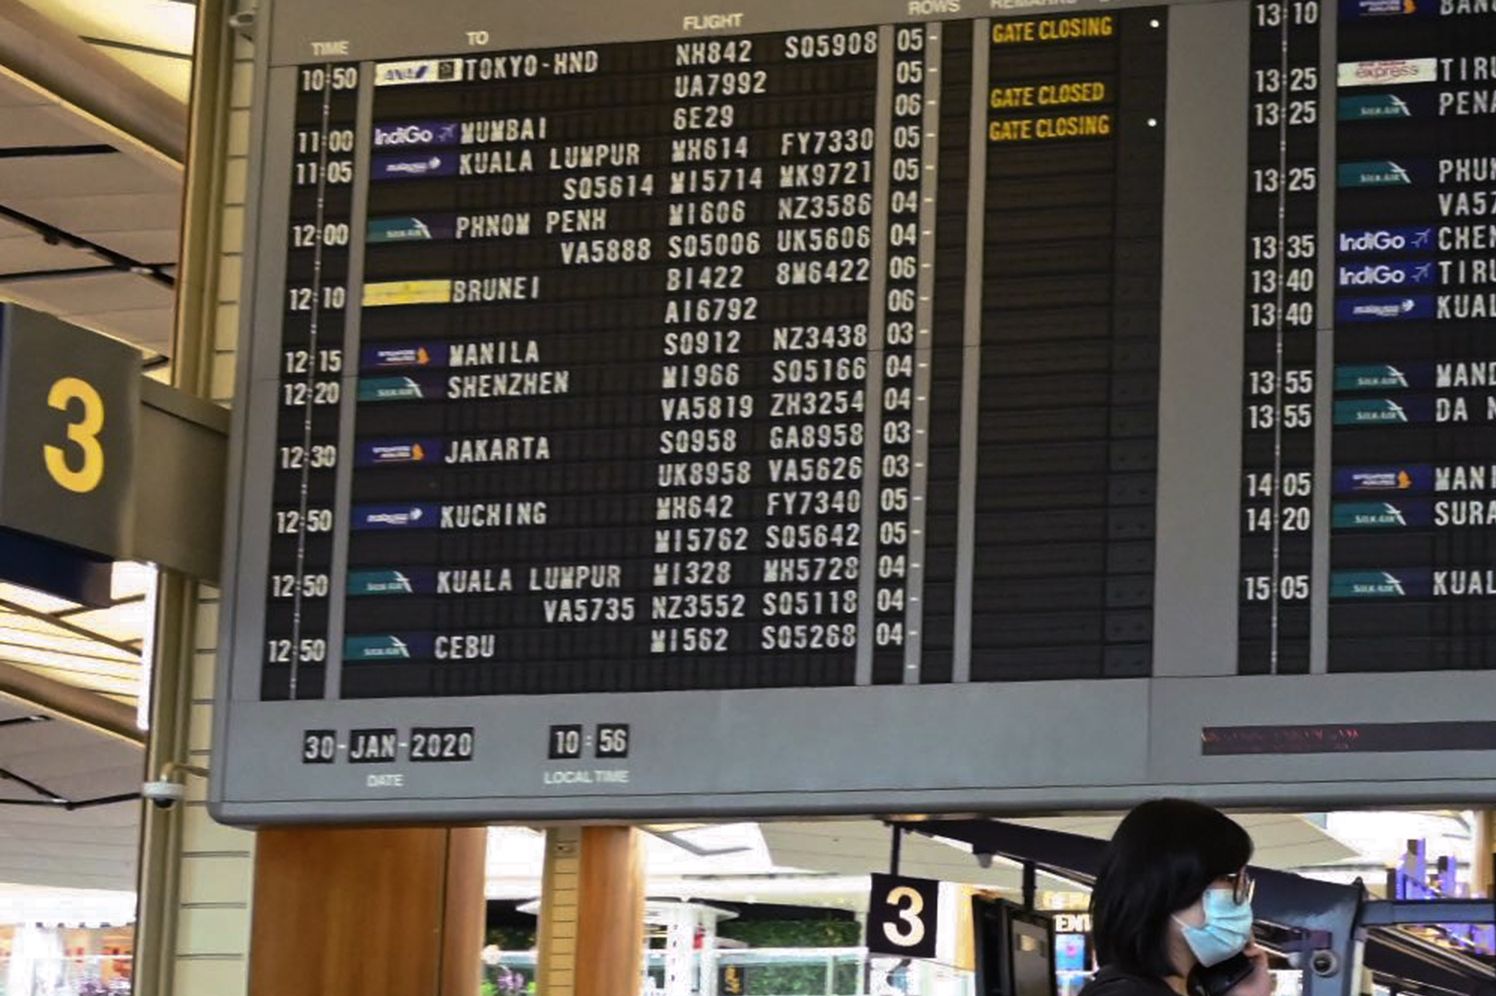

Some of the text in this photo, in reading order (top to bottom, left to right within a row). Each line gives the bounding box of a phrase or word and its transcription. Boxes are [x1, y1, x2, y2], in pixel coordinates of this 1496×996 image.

[683, 12, 743, 30] FLIGHT
[908, 0, 961, 16] ROWS
[466, 30, 489, 46] TO
[992, 17, 1113, 43] GATE CLOSING
[311, 40, 349, 56] TIME
[676, 39, 752, 66] NH842
[465, 50, 598, 81] TOKYO-HND
[675, 70, 767, 98] UA7992
[990, 83, 1104, 109] GATE CLOSED
[461, 117, 546, 144] MUMBAI
[673, 104, 734, 130] 6E29
[989, 116, 1111, 141] GATE CLOSING
[374, 125, 434, 145] IndiGo
[781, 127, 873, 156] FY7330
[459, 143, 640, 175] KUALA LUMPUR
[778, 192, 872, 220] NZ3586
[456, 208, 606, 239] PHNOM PENH
[560, 237, 651, 264] VA5888
[777, 225, 870, 252] UK5606
[1340, 231, 1406, 252] IndiGo
[1340, 265, 1406, 286] IndiGo
[452, 276, 539, 303] BRUNEI
[773, 323, 867, 351] NZ3438
[449, 340, 539, 367] MANILA
[447, 370, 569, 399] SHENZHEN
[661, 394, 753, 421] VA5819
[770, 390, 864, 417] ZH3254
[1436, 397, 1468, 422] DA
[43, 376, 105, 494] 3
[770, 422, 863, 450] GA8958
[445, 436, 550, 464] JAKARTA
[658, 460, 751, 487] UK8958
[769, 456, 863, 482] VA5626
[440, 501, 546, 528] KUCHING
[767, 489, 861, 516] FY7340
[437, 564, 621, 594] KUALA LUMPUR
[544, 597, 634, 623] VA5735
[652, 593, 745, 619] NZ3552
[435, 634, 495, 659] CEBU
[366, 774, 404, 788] DATE
[543, 769, 630, 785] LOCAL TIME
[882, 886, 925, 947] 3
